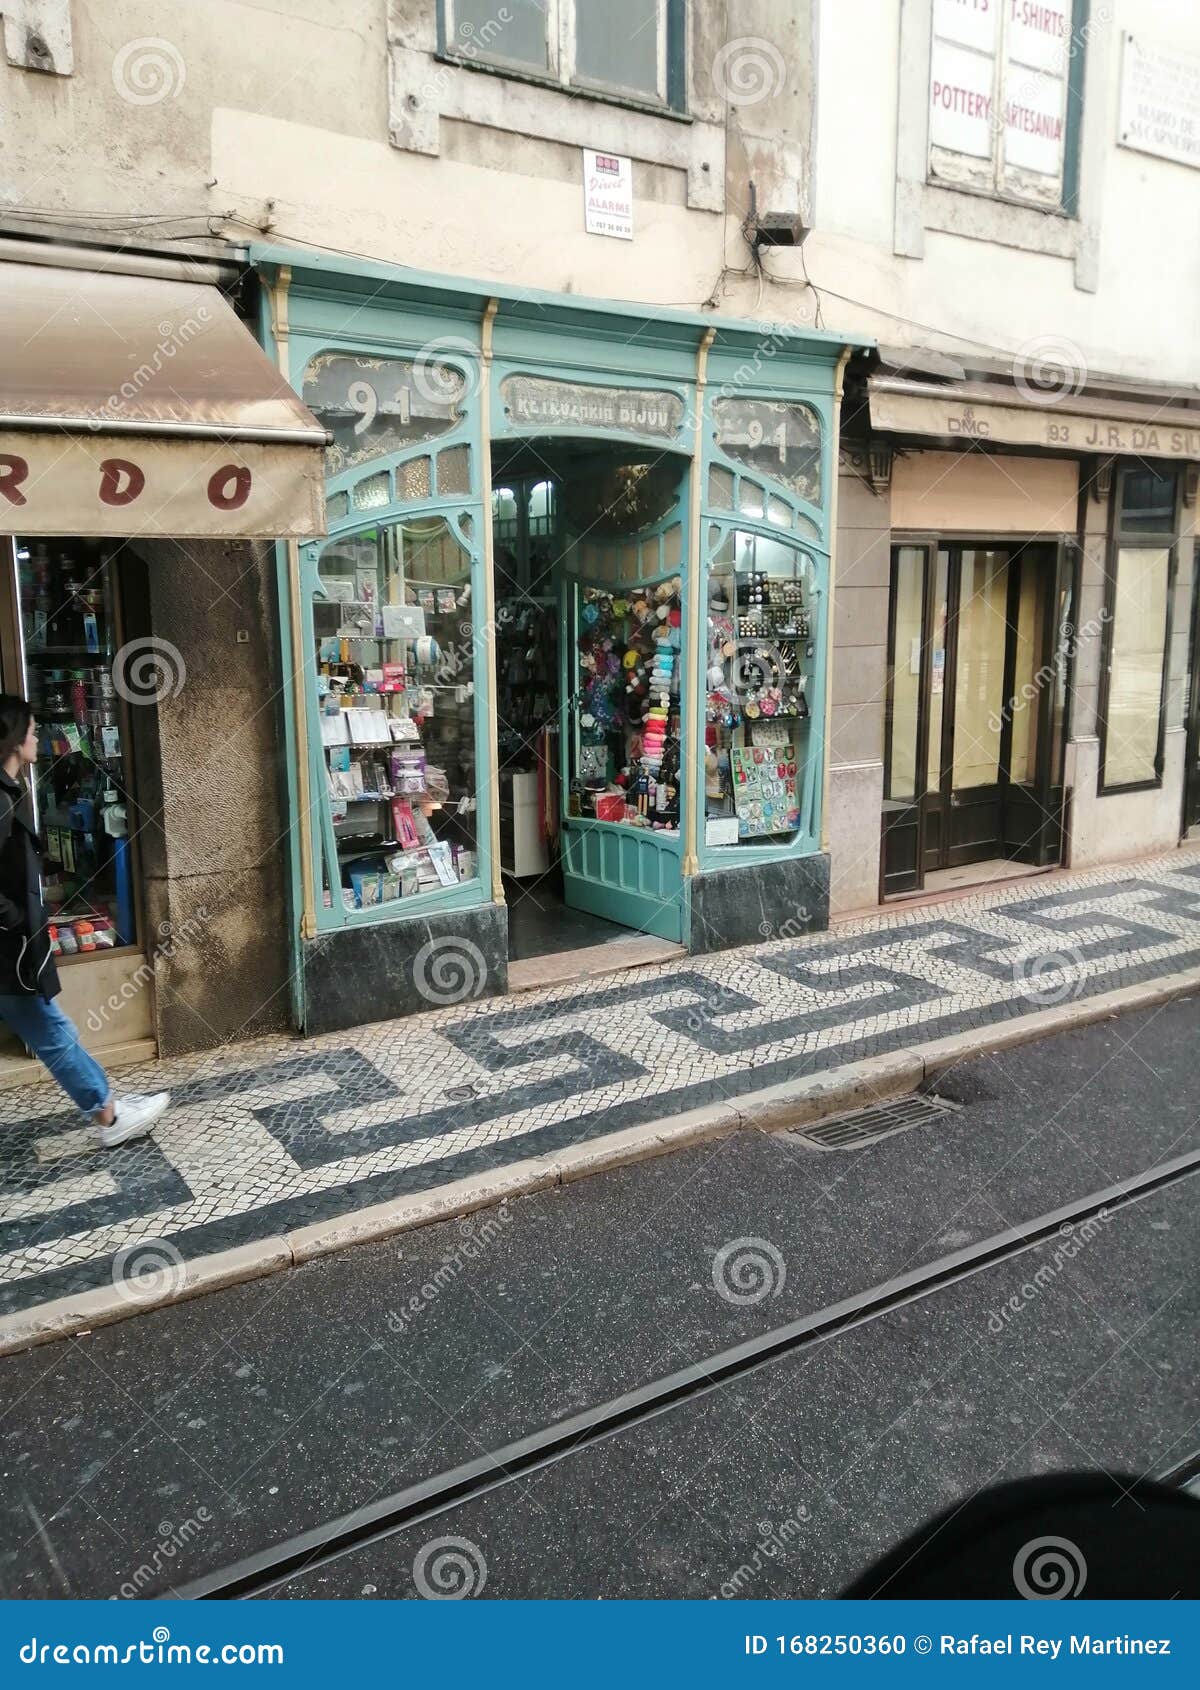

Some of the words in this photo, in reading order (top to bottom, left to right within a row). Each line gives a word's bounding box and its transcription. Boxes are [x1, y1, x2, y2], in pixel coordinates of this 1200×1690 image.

[933, 81, 992, 120] POTTERY
[1004, 100, 1063, 141] ARTESANIA
[588, 197, 630, 214] ALARME
[348, 381, 411, 435] 91
[948, 417, 990, 436] DMC
[748, 420, 788, 464] 91
[1049, 424, 1070, 442] 93
[1132, 428, 1160, 450] DA
[1170, 431, 1200, 454] SIL
